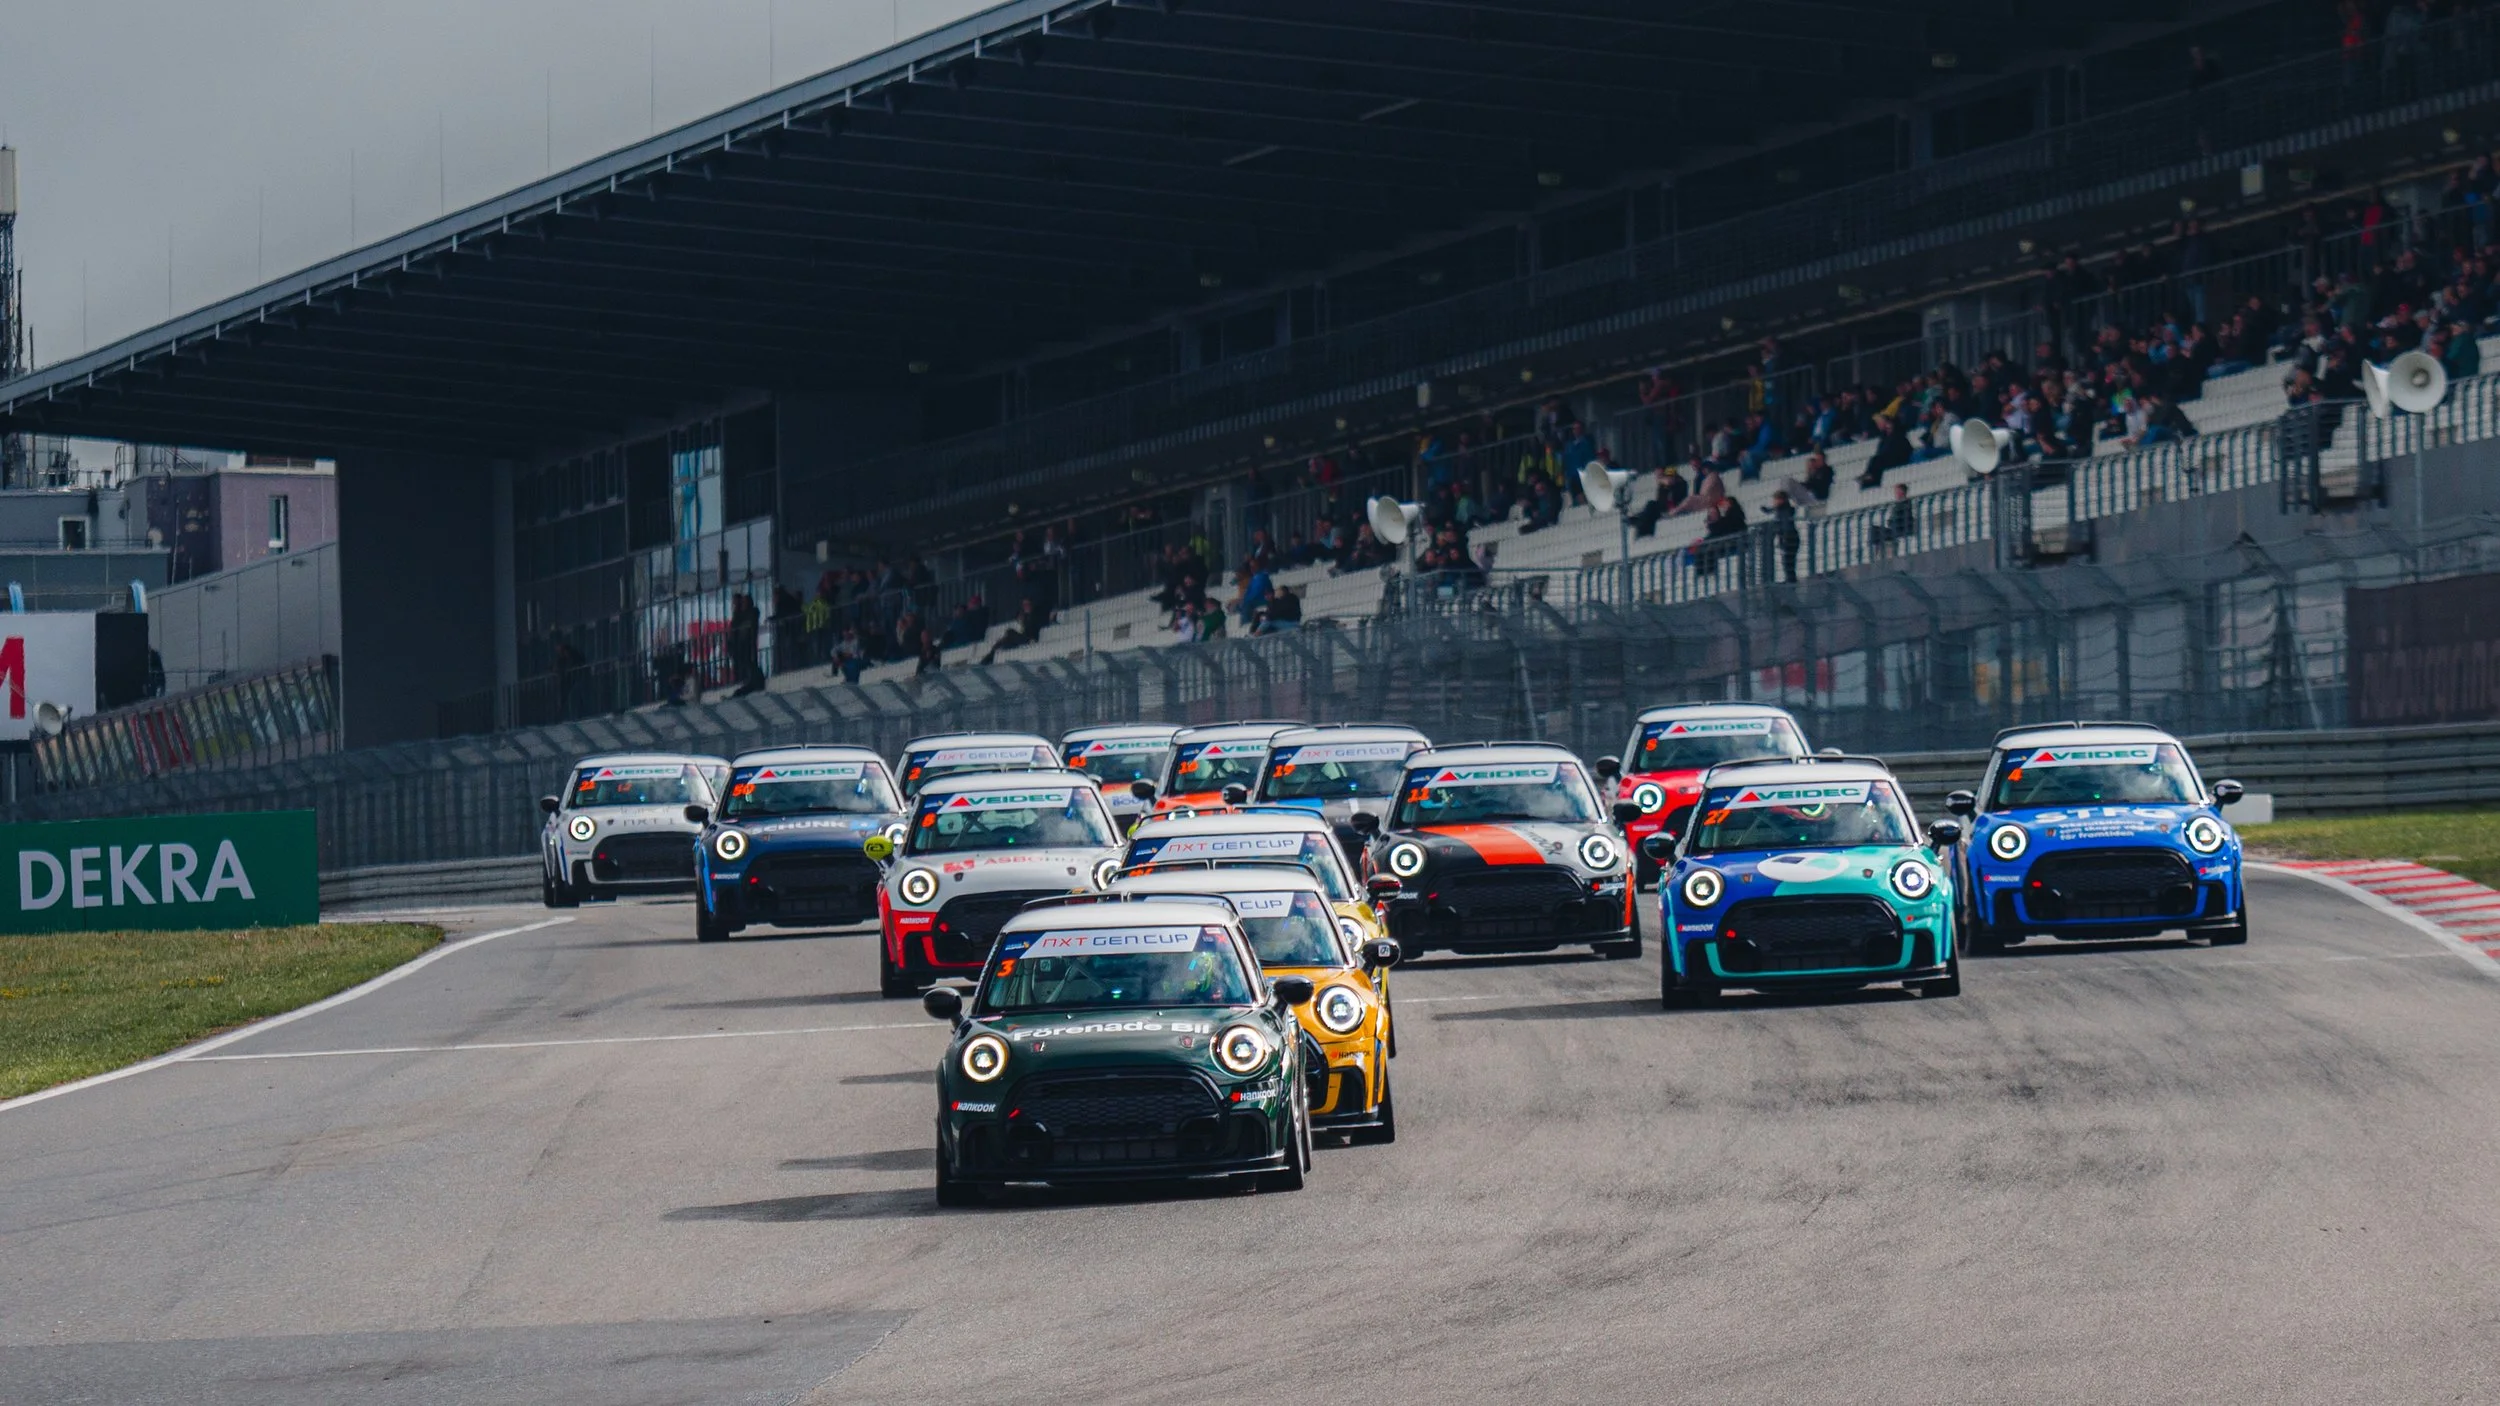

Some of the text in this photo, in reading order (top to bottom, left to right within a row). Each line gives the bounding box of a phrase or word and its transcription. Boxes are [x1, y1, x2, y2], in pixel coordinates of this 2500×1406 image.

[1685, 723, 1764, 732] VEIDEC
[1300, 749, 1332, 758] NXT
[2052, 750, 2149, 760] VEIDEC
[775, 767, 857, 777] VEIDEC
[908, 766, 922, 780] 2
[1455, 769, 1549, 779] VEIDEC
[2007, 767, 2024, 783] 4
[966, 793, 1064, 806] VEIDEC
[1756, 787, 1861, 800] VEIDEC
[1703, 809, 1732, 827] 27
[750, 821, 849, 835] SCHUNK
[1168, 842, 1208, 854] NXT
[1211, 841, 1252, 852] GEN
[1255, 839, 1294, 850] CUP
[18, 839, 256, 911] DEKRA
[1239, 899, 1283, 910] CUP
[1042, 936, 1089, 949] NXT
[1092, 935, 1139, 947] GEN
[1142, 933, 1189, 945] CUP
[996, 958, 1017, 978] 3
[1013, 1021, 1163, 1042] Förenade
